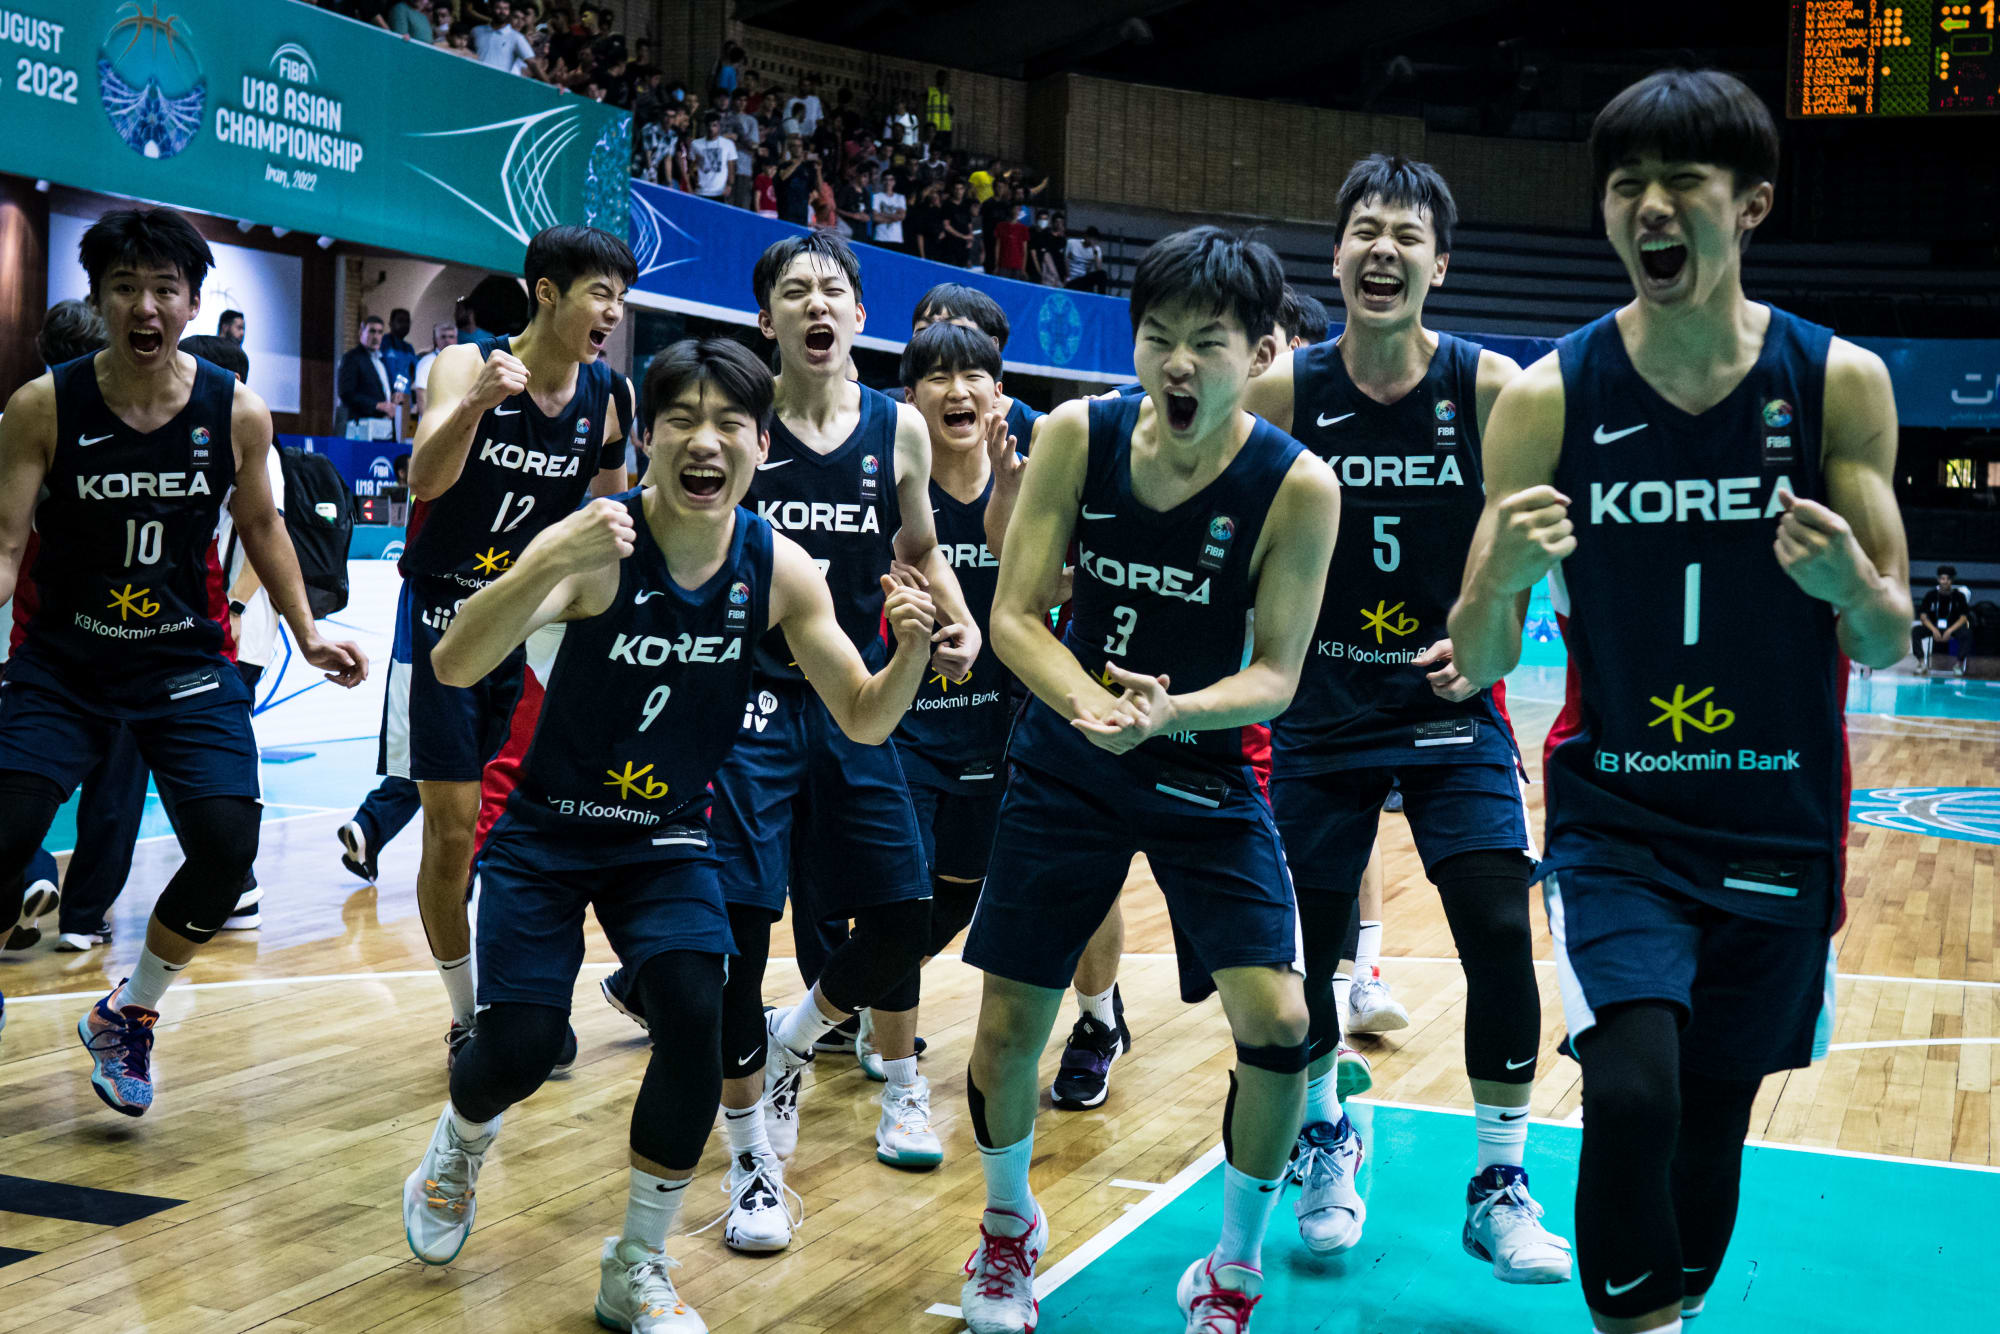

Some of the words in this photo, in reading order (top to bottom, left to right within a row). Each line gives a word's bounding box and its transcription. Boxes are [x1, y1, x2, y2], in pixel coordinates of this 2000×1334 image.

[279, 57, 309, 84] FIBA
[1804, 57, 1859, 68] M.SOLTANI
[17, 58, 78, 104] 2022
[242, 76, 279, 115] U18
[284, 88, 342, 132] ASIAN
[215, 107, 364, 173] CHAMPIONSHIP
[292, 169, 317, 191] 2022
[1438, 427, 1455, 436] FIBA
[478, 438, 580, 478] KOREA
[76, 471, 212, 500] KOREA
[862, 479, 876, 488] FIBA
[1590, 475, 1795, 525] KOREA
[489, 491, 536, 533] 12
[757, 501, 880, 534] KOREA
[124, 519, 164, 568] 10
[1205, 544, 1225, 559] FIBA
[1373, 516, 1400, 572] 5
[1079, 540, 1210, 605] KOREA
[728, 609, 746, 620] FIBA
[1683, 563, 1701, 645] 1
[74, 612, 92, 630] KB
[92, 620, 156, 640] Kookmin
[159, 616, 195, 634] Bank
[1104, 605, 1138, 657] 3
[608, 633, 742, 667] KOREA
[1317, 640, 1344, 658] KB
[1347, 644, 1415, 665] Kookmin
[638, 685, 671, 732] 9
[916, 694, 968, 711] Kookmin
[972, 690, 1000, 706] Bank
[1624, 749, 1732, 773] Kookmin
[1738, 749, 1800, 771] Bank
[578, 800, 661, 826] Kookmin
